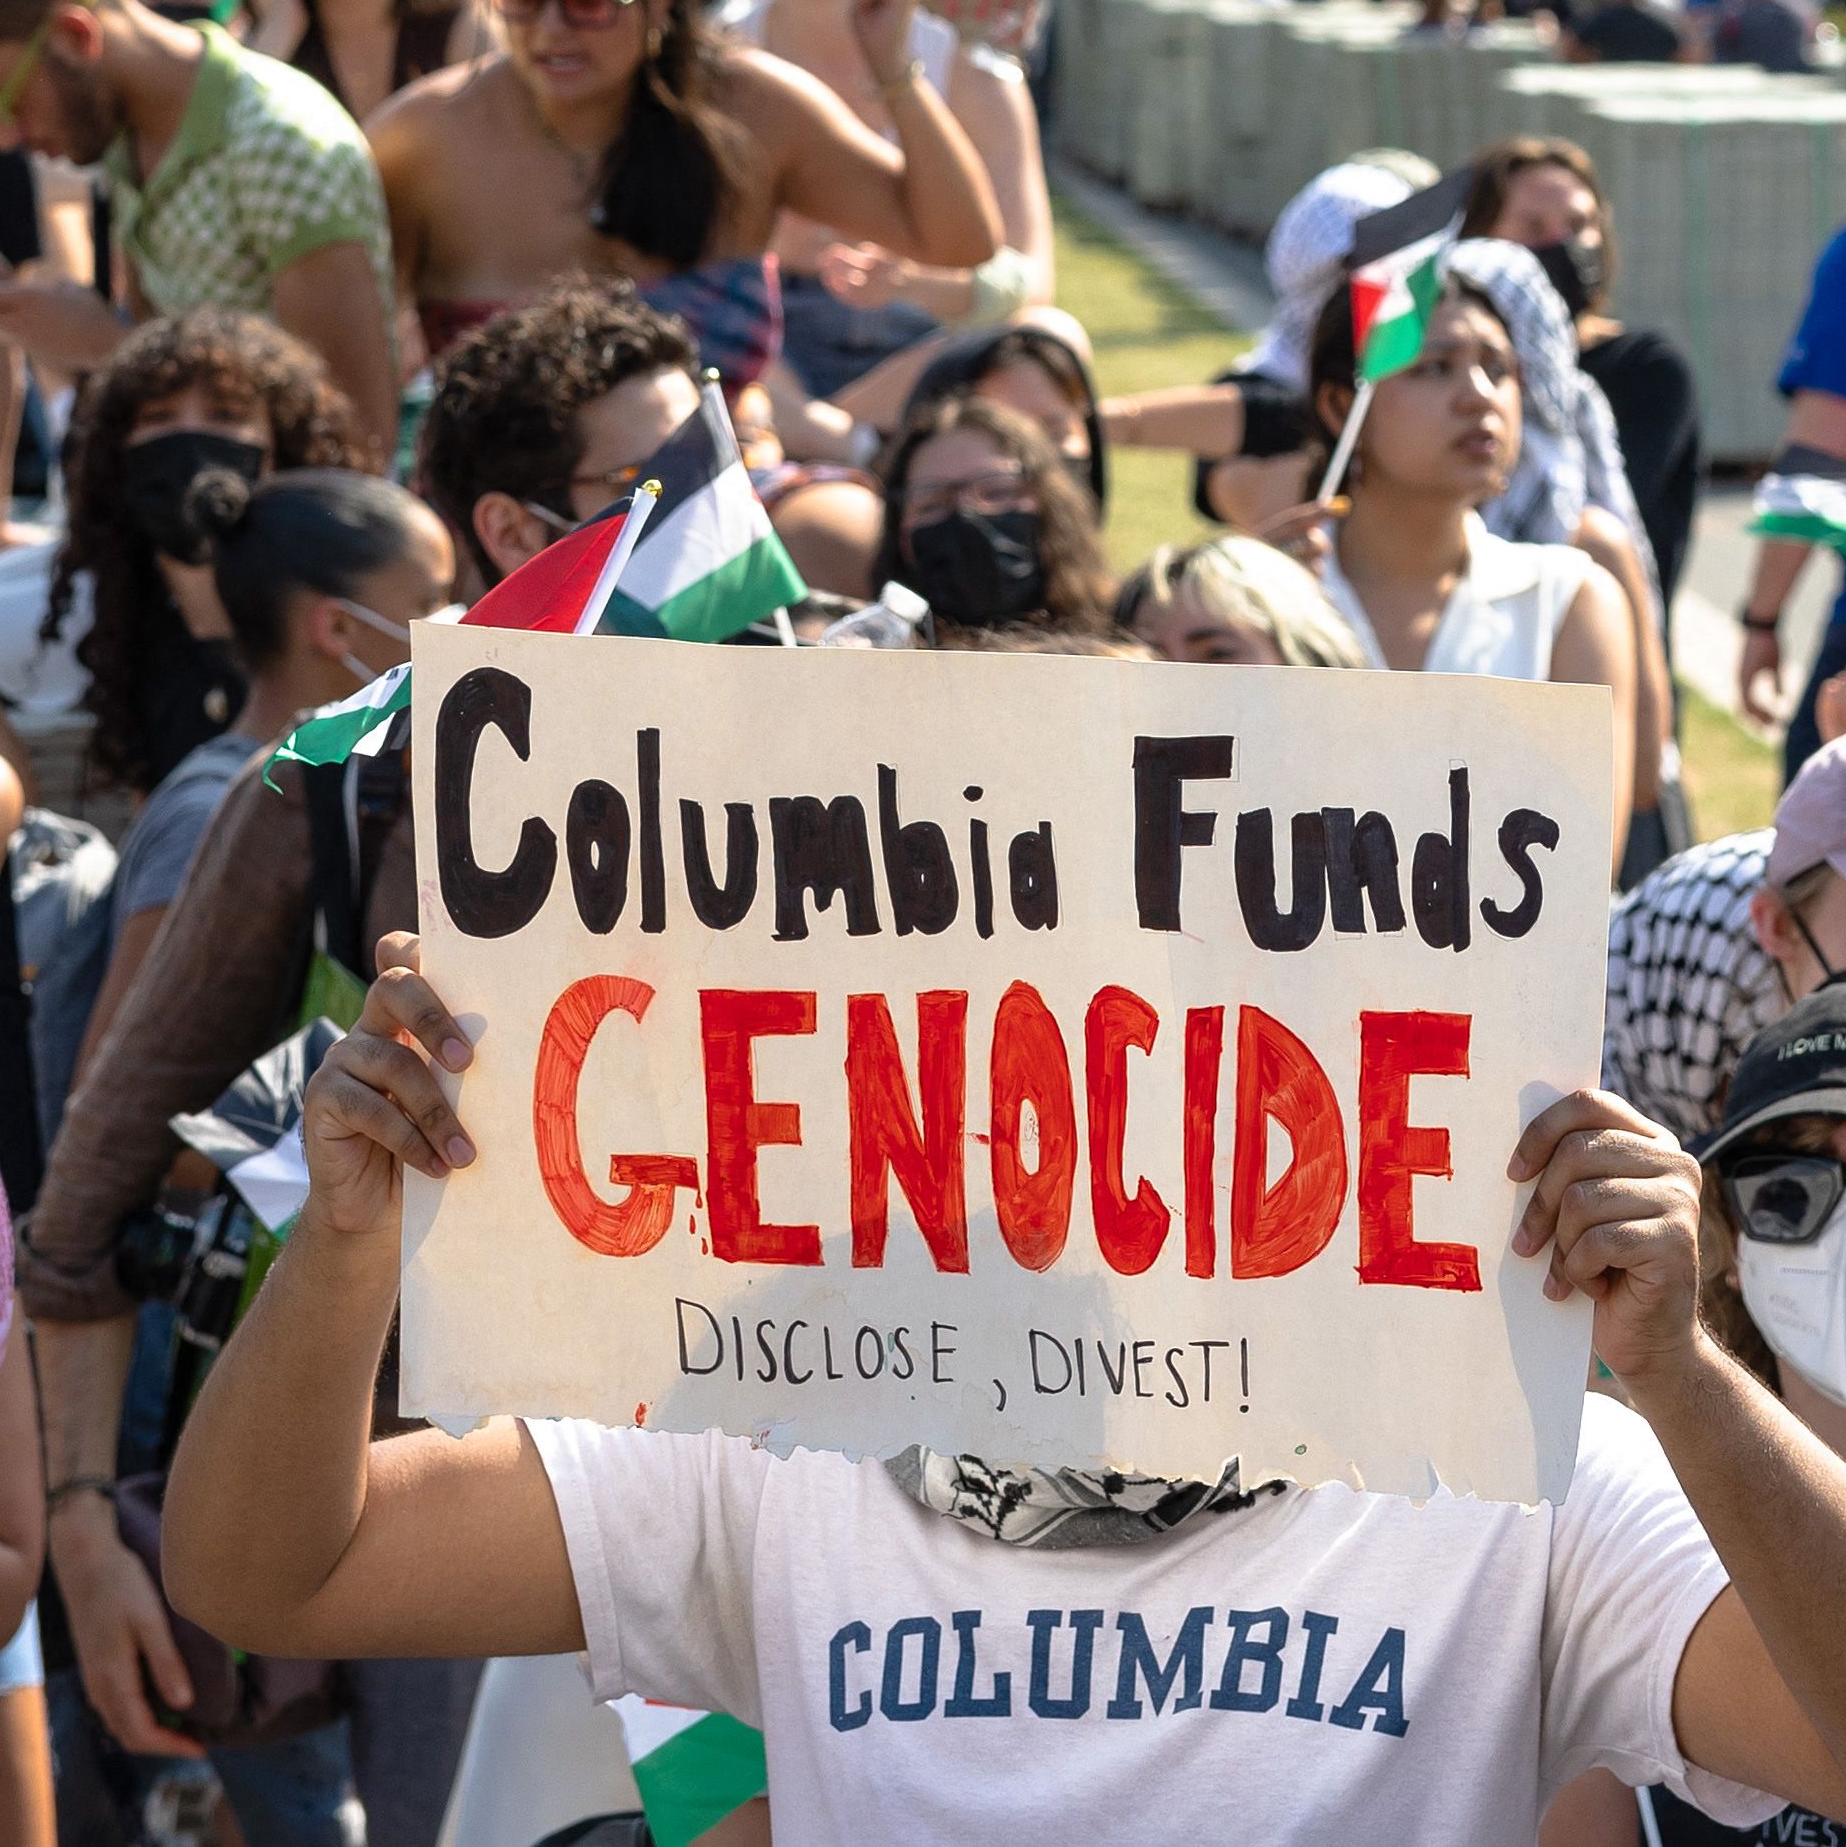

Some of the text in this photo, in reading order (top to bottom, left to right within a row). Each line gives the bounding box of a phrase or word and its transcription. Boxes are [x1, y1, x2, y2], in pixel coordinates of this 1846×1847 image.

[434, 666, 1560, 953] Columbia Funds
[1784, 1033, 1832, 1058] LOVE
[533, 974, 1483, 1294] GENOCIDE
[1028, 1328, 1249, 1408] DIVEST!
[829, 1606, 1411, 1739] COLUMBIA
